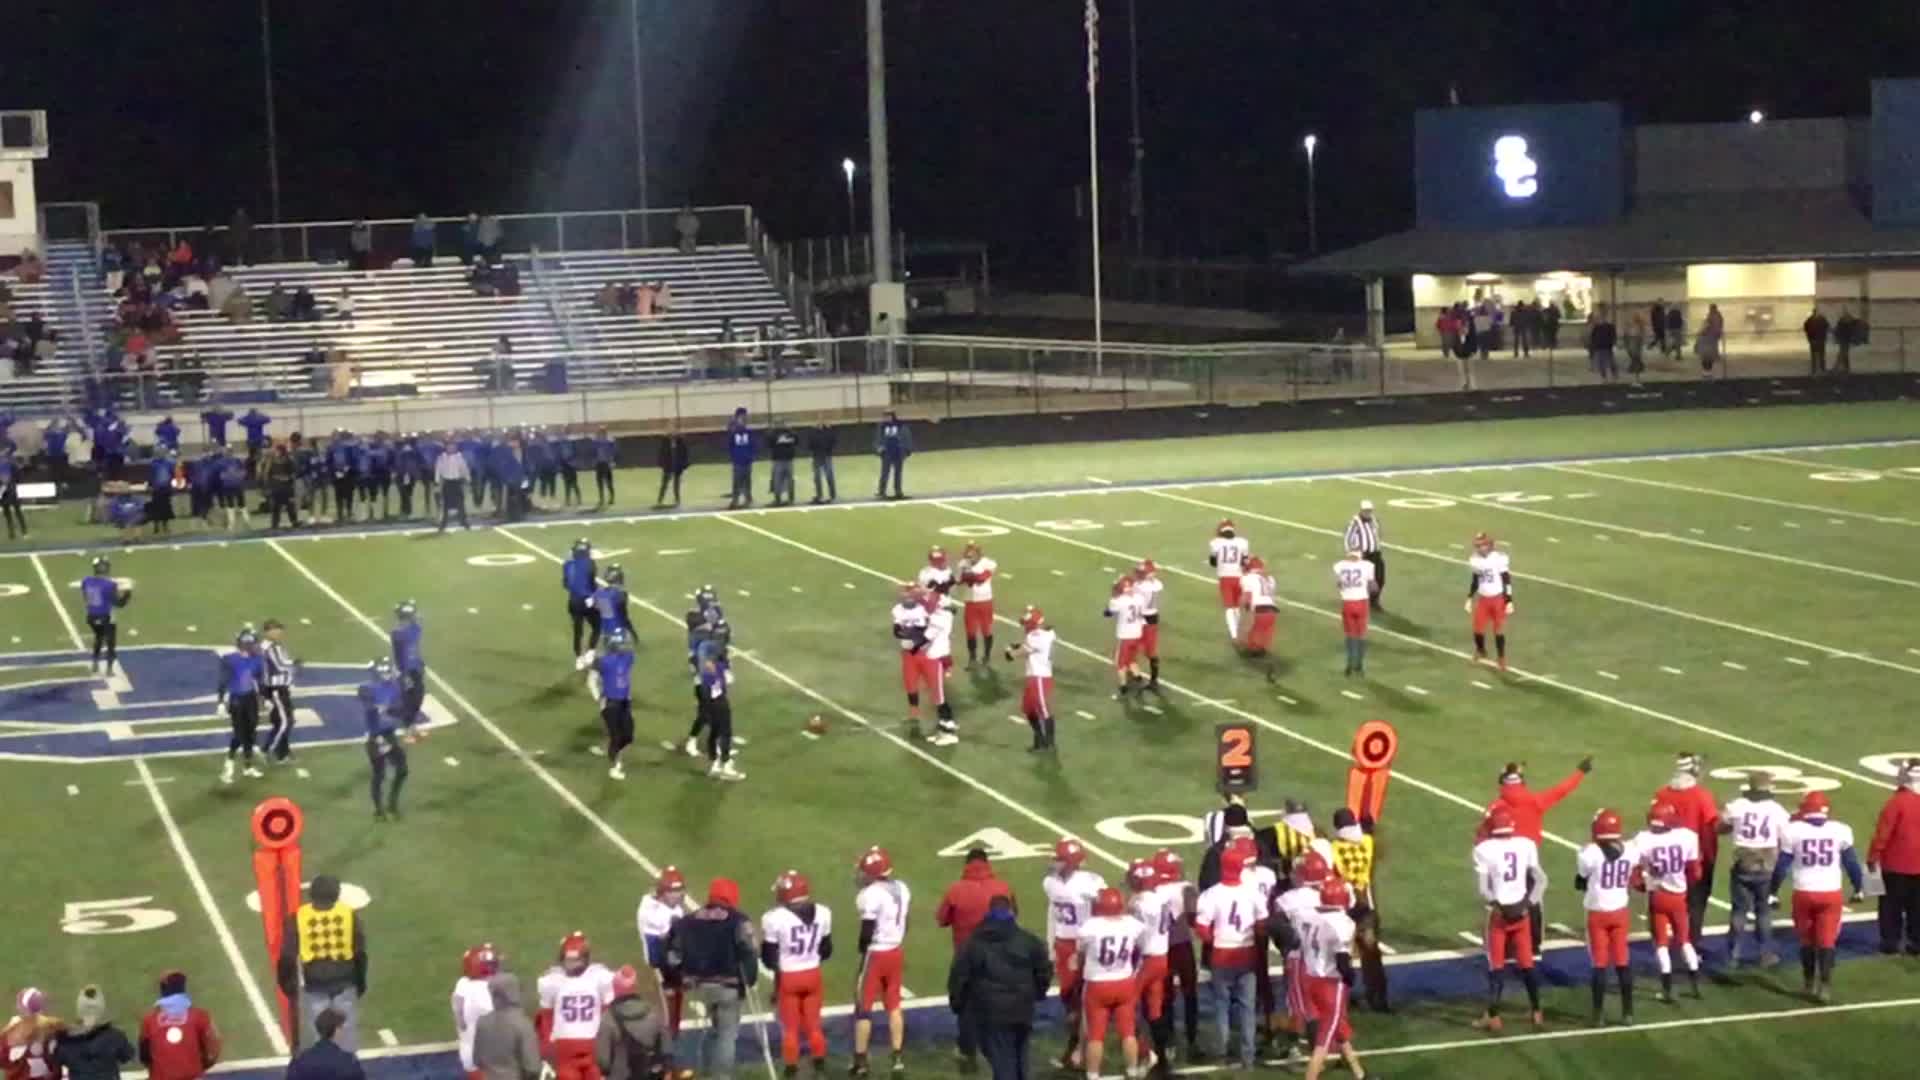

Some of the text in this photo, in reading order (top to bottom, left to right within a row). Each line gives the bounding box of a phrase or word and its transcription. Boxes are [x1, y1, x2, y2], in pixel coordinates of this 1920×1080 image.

[1222, 545, 1239, 564] 13
[1340, 569, 1362, 588] 32
[1221, 728, 1252, 767] 2
[1741, 812, 1771, 840] 54
[1503, 852, 1518, 882] 3
[1801, 838, 1834, 867] 55
[1601, 859, 1631, 889] 88
[61, 896, 177, 934] 5
[1228, 899, 1242, 932] 4
[790, 924, 818, 955] 57
[1098, 935, 1129, 967] 64
[561, 995, 595, 1023] 52
